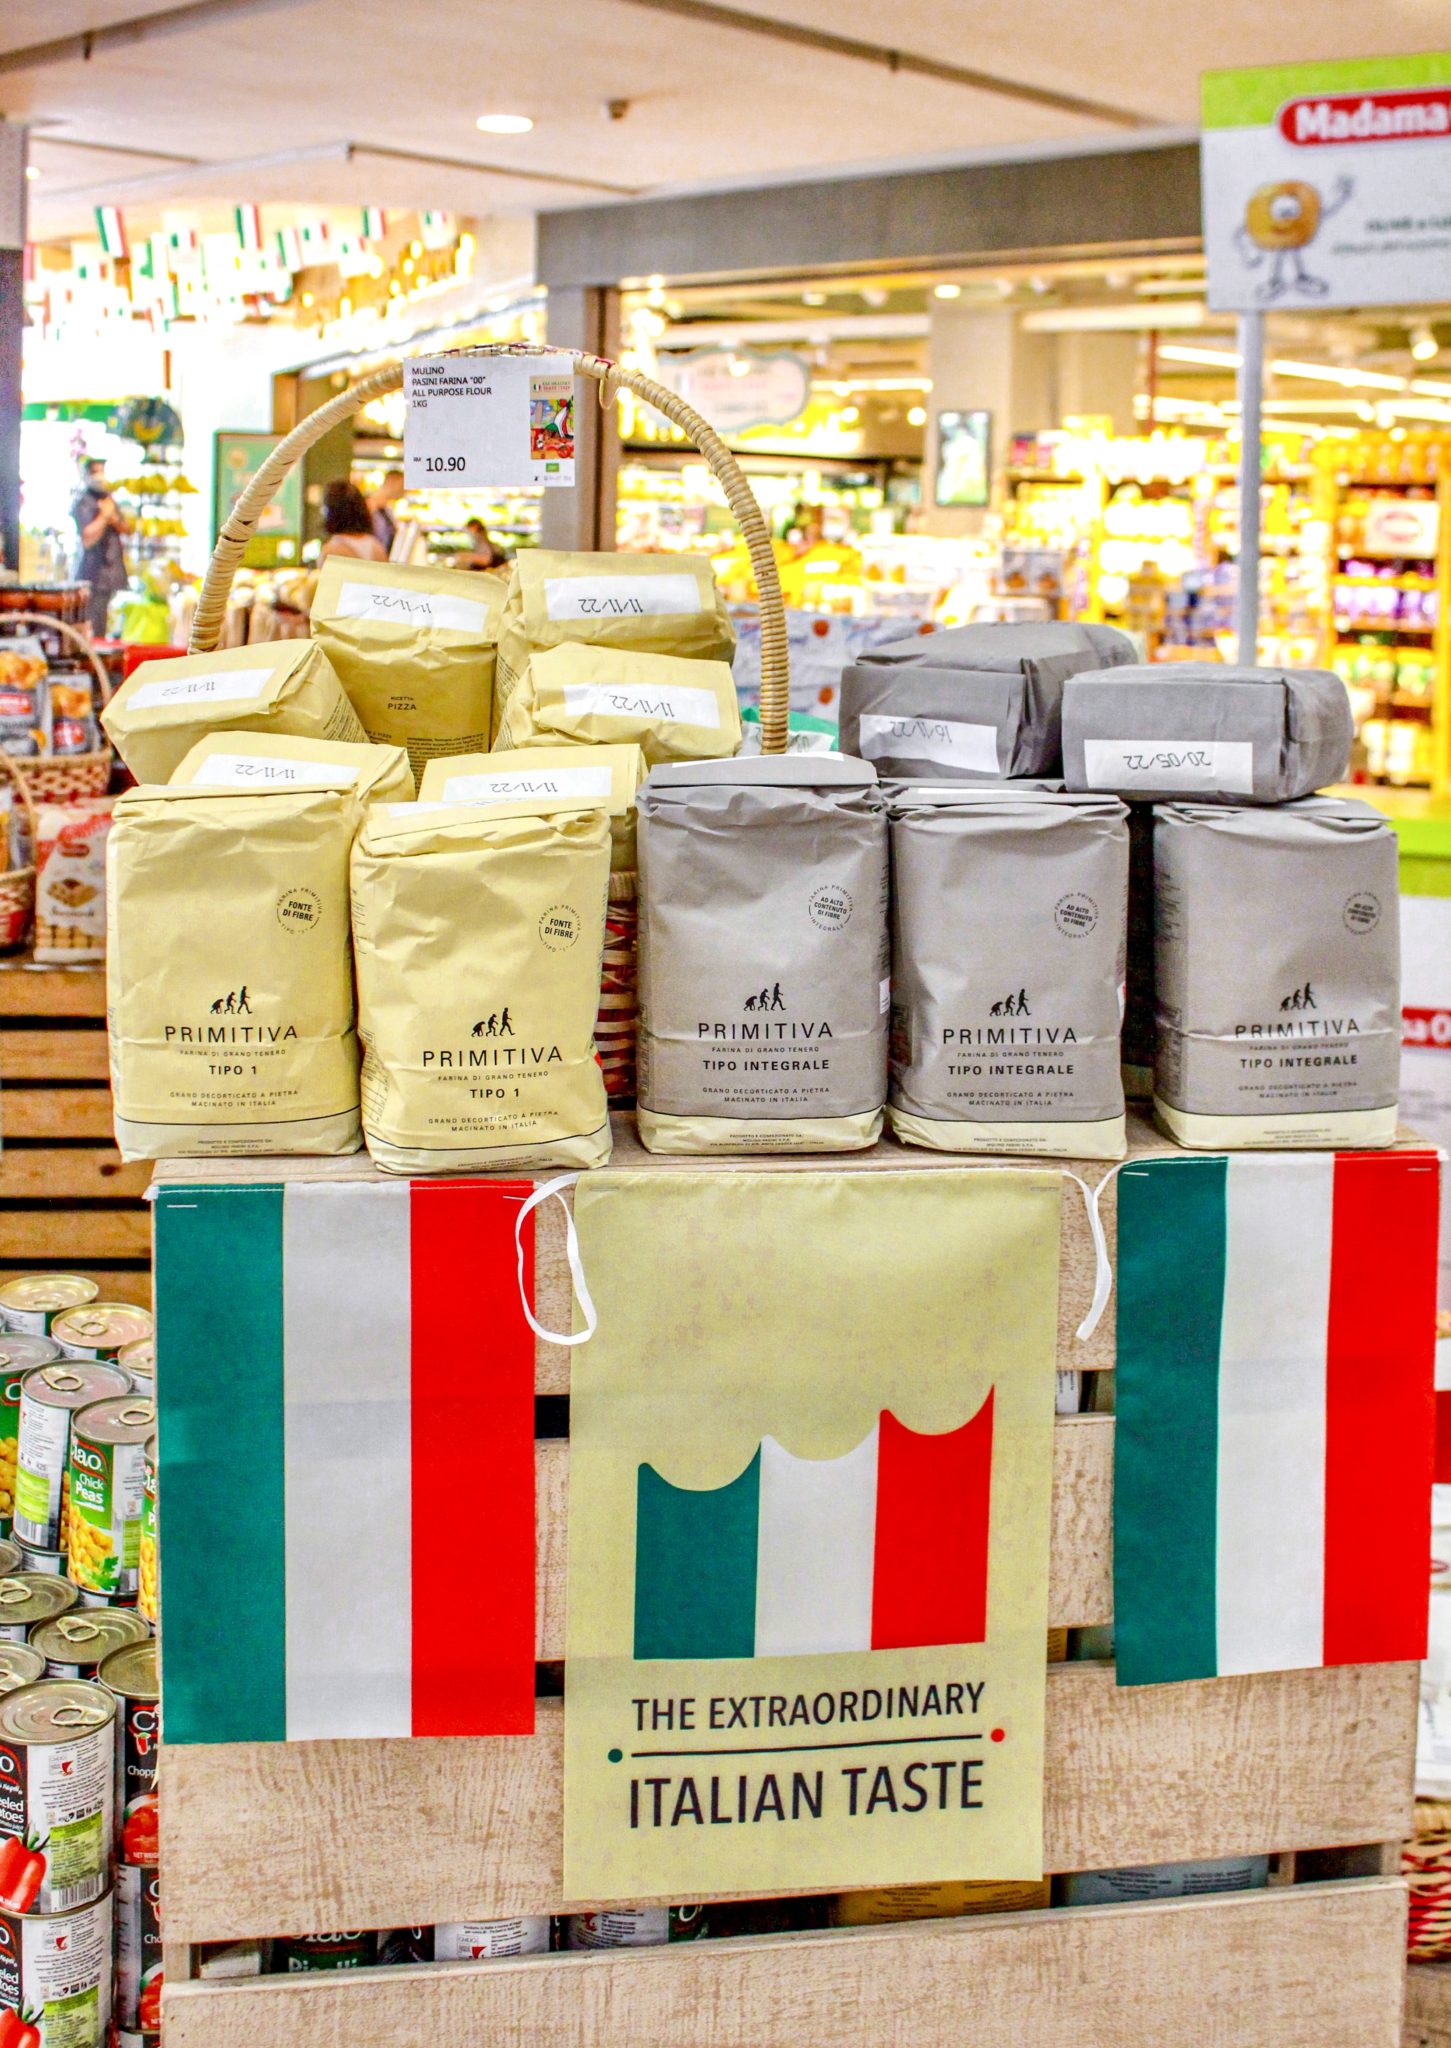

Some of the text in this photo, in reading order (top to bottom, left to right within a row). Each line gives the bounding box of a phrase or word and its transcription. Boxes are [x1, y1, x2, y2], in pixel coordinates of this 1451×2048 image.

[1296, 98, 1448, 142] Madama
[412, 367, 444, 375] MULINO
[412, 376, 438, 386] PASINI
[439, 376, 468, 385] FARINA
[412, 387, 492, 397] ALL PURPOSE FLOUR
[412, 400, 428, 408] 1KG
[426, 457, 466, 472] 10.90
[578, 598, 644, 613] 11/11/22
[387, 703, 416, 711] PIZZA
[609, 695, 675, 718] 11/11/22
[1123, 751, 1212, 770] 20/05/22
[235, 763, 296, 780] 11/11/22
[490, 782, 559, 793] 11/11/22
[288, 901, 313, 912] FONTE
[814, 902, 848, 915] CONTENUTO
[830, 899, 844, 907] ALTO
[282, 908, 314, 922] DI FIBRE
[824, 911, 841, 920] FIBRE
[1075, 906, 1090, 914] ALTO
[550, 918, 572, 929] FONTE
[544, 926, 574, 939] DI FIBRE
[164, 1025, 298, 1043] PRIMITIVA
[698, 1022, 833, 1040] PRIMITIVA
[1235, 1018, 1360, 1039] PRIMITIVA
[943, 1028, 1078, 1045] PRIMITIVA
[254, 1049, 286, 1057] TENERO
[423, 1046, 563, 1068] PRIMITIVA
[703, 1059, 830, 1071] TIPO INTEGRALE
[1240, 1054, 1358, 1069] TIPO INTEGRALE
[209, 1065, 258, 1075] TIPO 1
[517, 1070, 549, 1079] TENERO
[948, 1064, 1074, 1076] TIPO INTEGRALE
[169, 1091, 198, 1099] GRANO
[201, 1091, 257, 1099] DECORTICATO
[269, 1089, 299, 1098] PIETRA
[469, 1088, 520, 1099] TIPO 1
[461, 1114, 518, 1124] DECORTICATO
[511, 1120, 538, 1129] ITALIA
[71, 1443, 102, 1470] iao
[79, 1473, 104, 1491] Chick
[75, 1480, 104, 1504] Peas
[632, 1682, 985, 1732] THE EXTRAORDINARY
[127, 1765, 158, 1780] Chopp
[630, 1759, 984, 1829] ITALIAN TASTE
